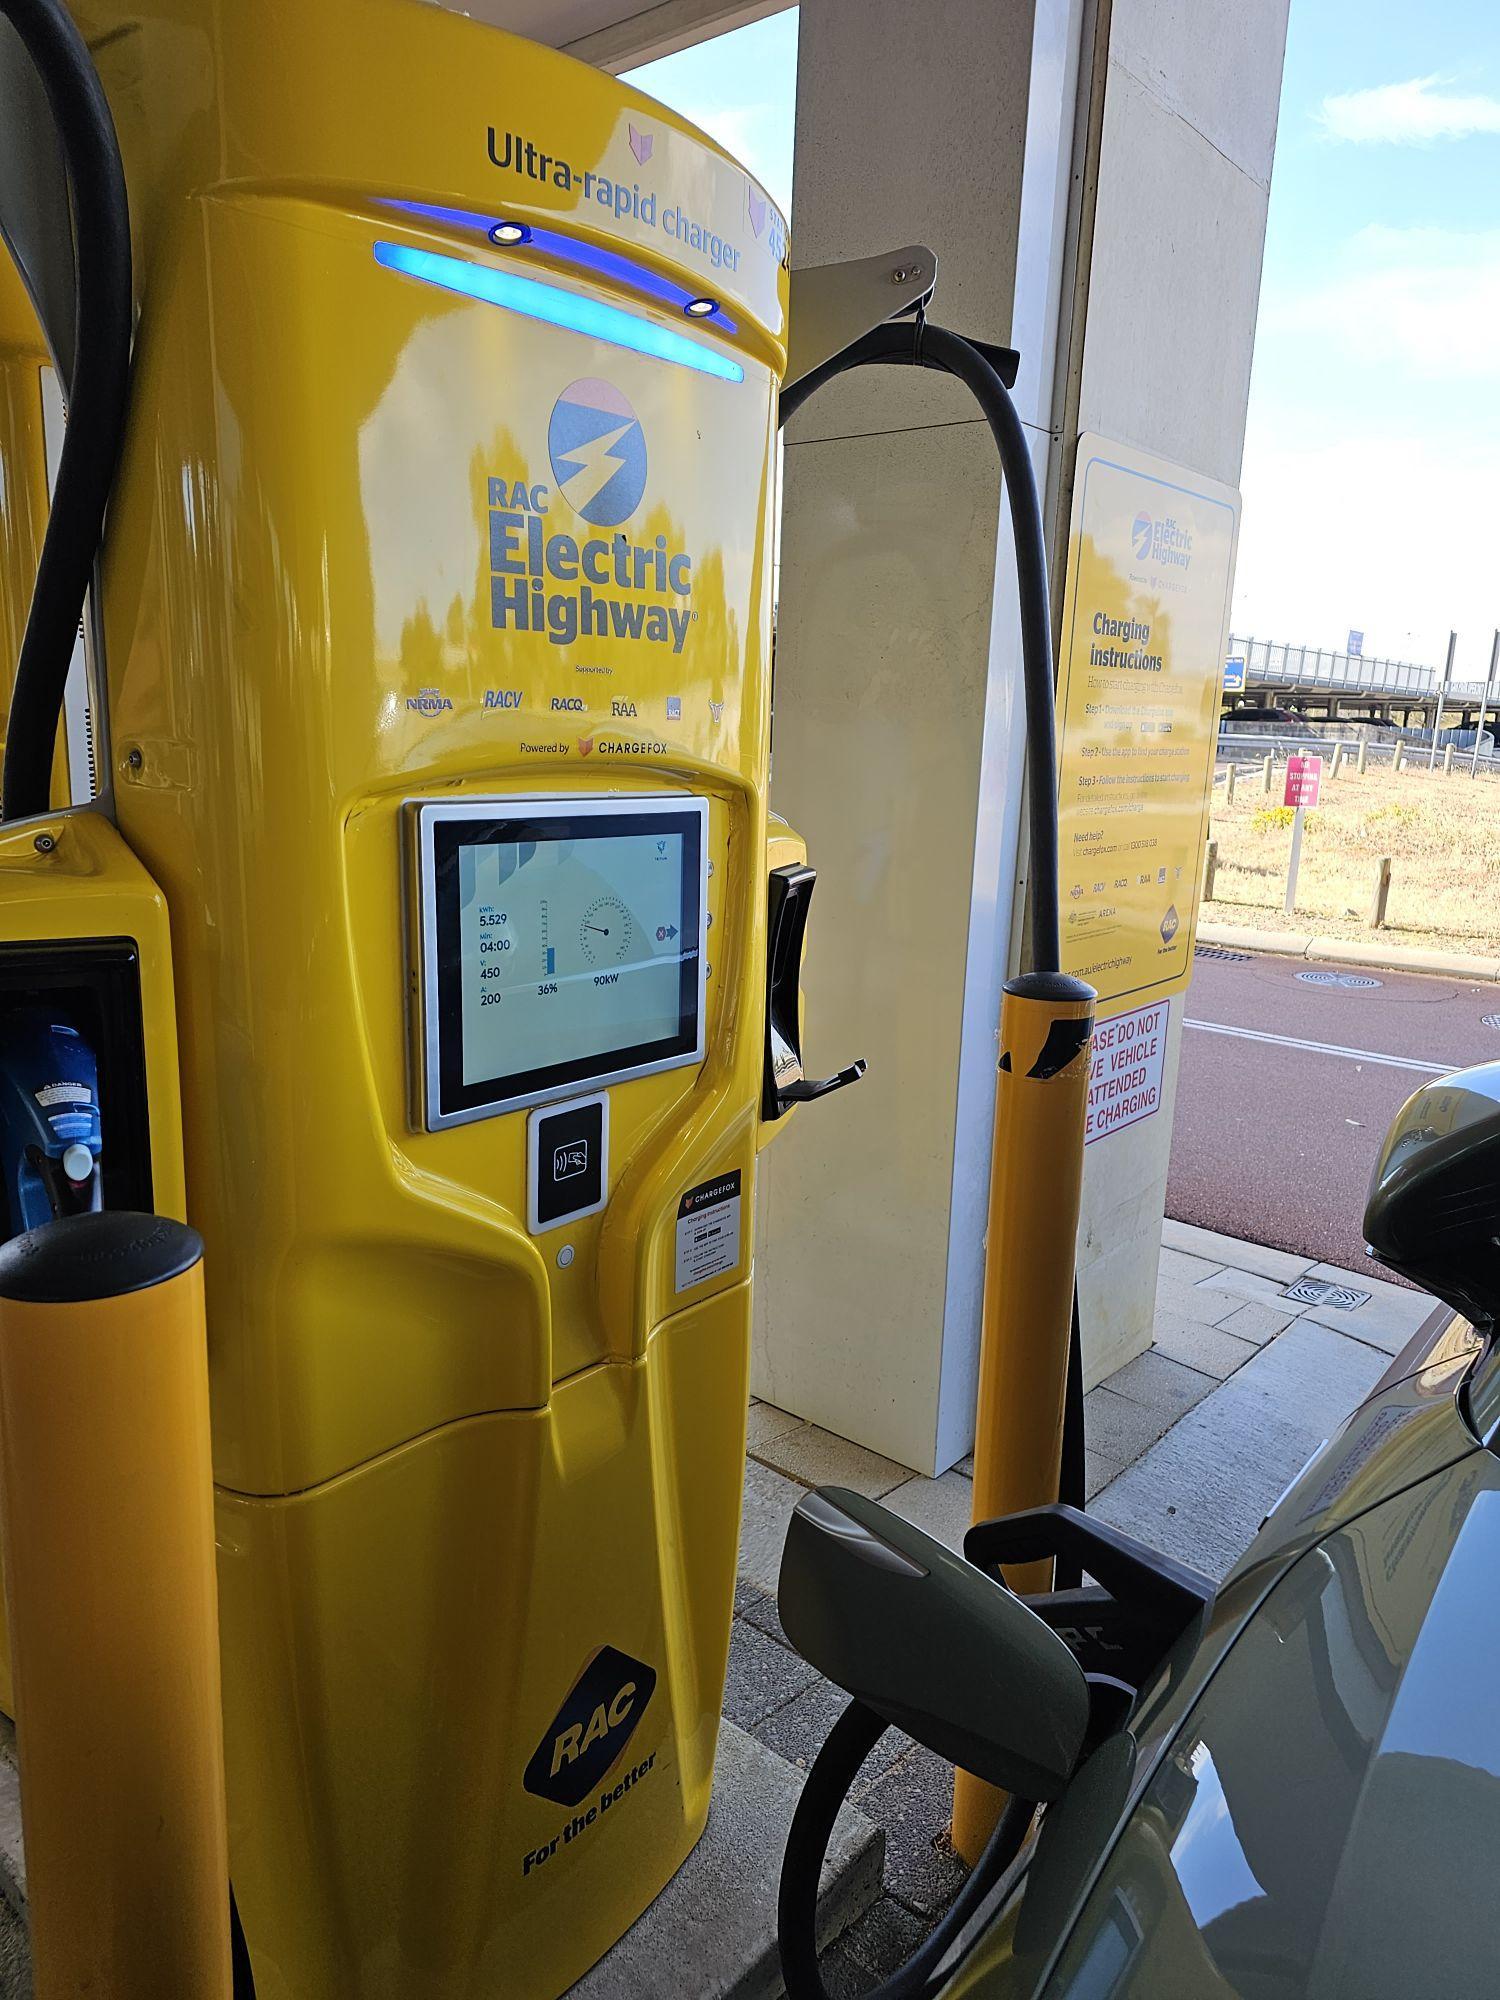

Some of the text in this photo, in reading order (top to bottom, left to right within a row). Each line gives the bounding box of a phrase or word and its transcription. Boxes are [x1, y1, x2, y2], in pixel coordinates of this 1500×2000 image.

[486, 126, 741, 273] Ultra-rapid charger
[487, 475, 549, 514] RAC
[1153, 520, 1193, 551] Electric
[488, 509, 692, 596] Electric
[1151, 541, 1192, 571] Highway
[490, 576, 692, 654] Highway
[1092, 611, 1150, 646] Charging
[1089, 642, 1163, 673] instructions
[575, 664, 613, 676] Supported by
[405, 689, 638, 717] NRMA RACV RACQ RAA
[1085, 703, 1098, 715] Step
[519, 741, 668, 756] Powered by CHARGEFOX
[1081, 747, 1095, 758] Step
[1102, 747, 1112, 757] Use
[1121, 749, 1132, 758] app
[1078, 776, 1092, 787] Step
[1098, 775, 1116, 785] Follow
[1116, 775, 1126, 784] the
[1126, 774, 1155, 784] instructions
[1291, 783, 1300, 792] AT
[1073, 830, 1104, 843] Need help?
[1083, 844, 1118, 857] chargefox.com
[479, 905, 495, 914] kWh:
[479, 913, 507, 927] 5.529
[1162, 918, 1177, 932] RAC
[479, 932, 493, 940] Min:
[480, 939, 511, 953] 04:00
[480, 959, 487, 967] V:
[1065, 956, 1133, 978] com.au/electrichighway
[480, 966, 500, 980] 450
[593, 972, 619, 987] 90kW
[537, 982, 558, 996] 36%
[480, 992, 501, 1006] 200
[1117, 1022, 1135, 1045] DO
[1137, 1011, 1161, 1037] NOT
[1110, 1037, 1158, 1072] VEHICLE
[1088, 1066, 1147, 1106] ATTENDED
[1096, 1086, 1156, 1129] CHARGING
[694, 1181, 736, 1204] CHARGEFOX
[687, 1213, 707, 1224] Charging
[549, 1681, 637, 1778] RAC
[523, 1751, 657, 1876] For the better
